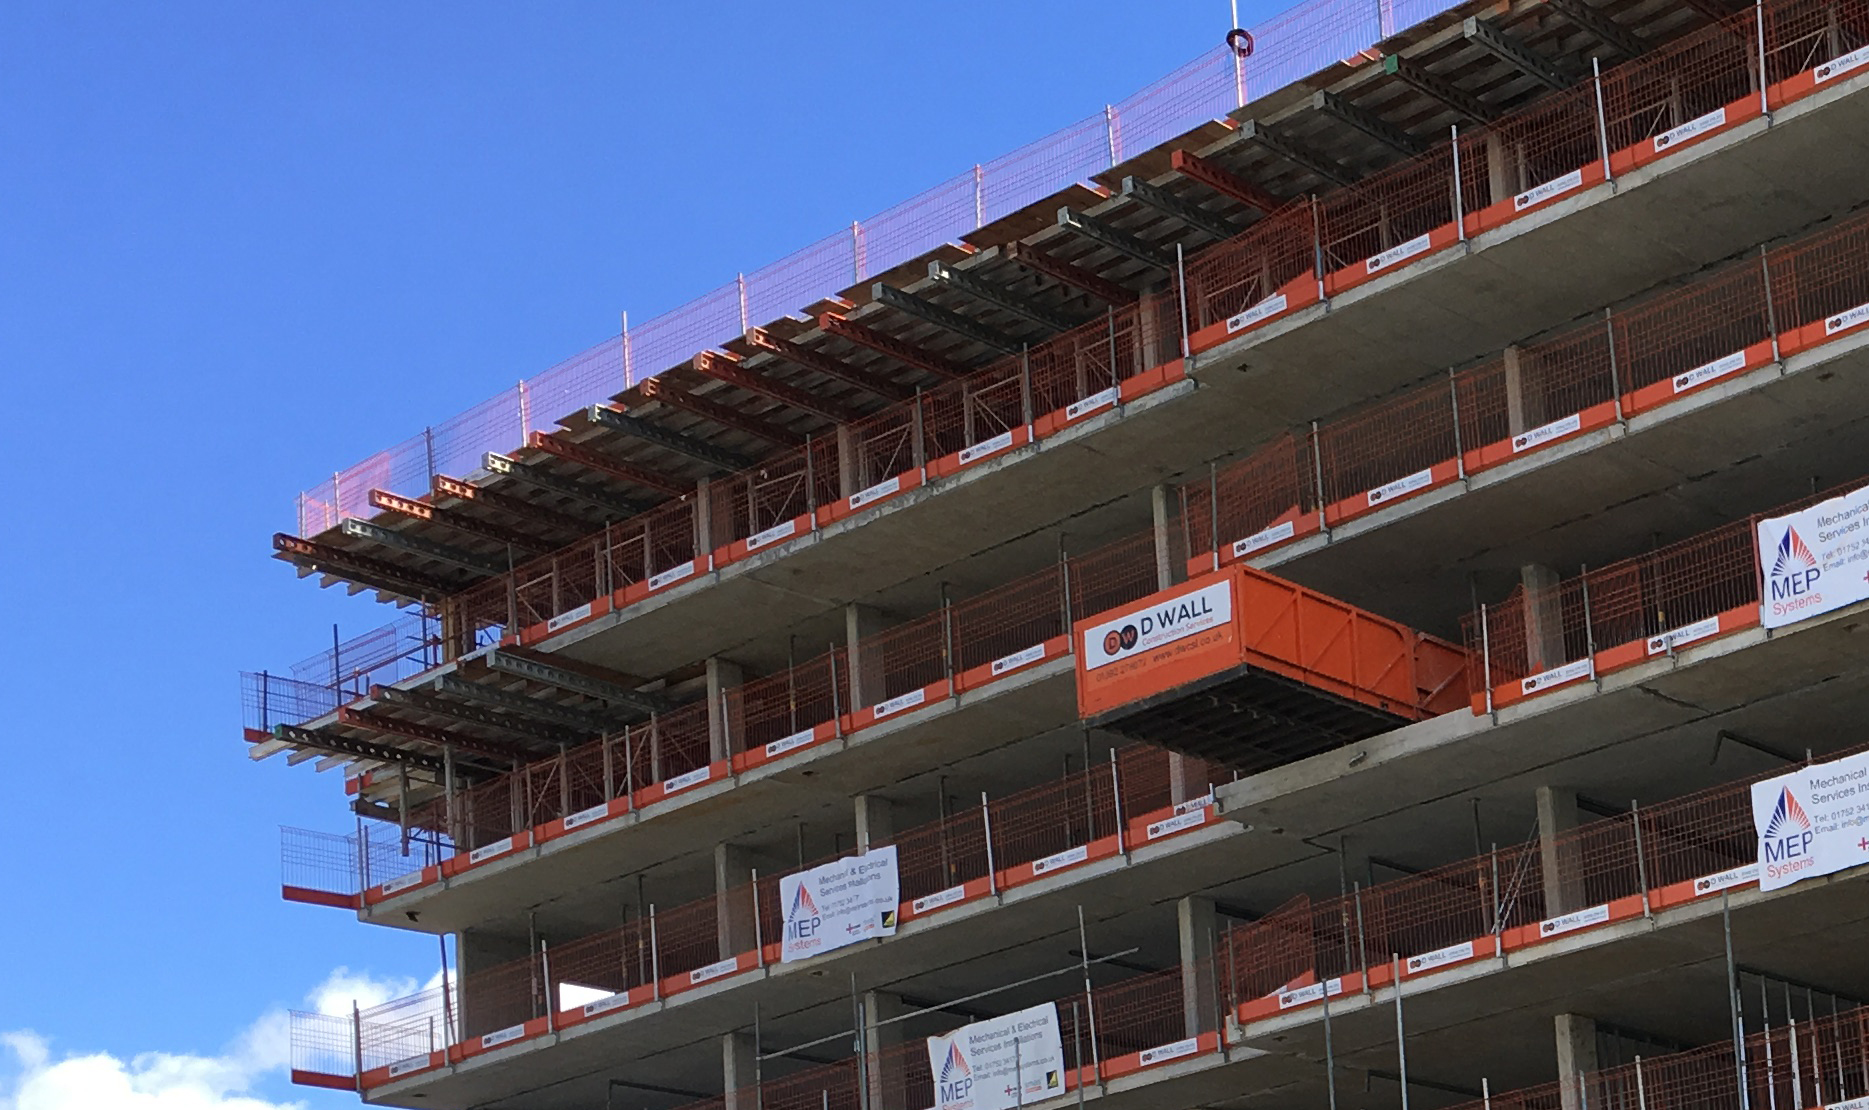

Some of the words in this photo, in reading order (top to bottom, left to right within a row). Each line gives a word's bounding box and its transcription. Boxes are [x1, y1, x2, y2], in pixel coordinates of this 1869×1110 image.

[1838, 53, 1858, 67] WALL
[1677, 123, 1695, 136] WALL
[1849, 306, 1869, 320] WALL
[1696, 364, 1715, 378] WALL
[1819, 520, 1860, 542] Services
[1772, 568, 1820, 601] MEP
[1773, 592, 1822, 616] Systems
[1141, 617, 1153, 636] D
[1157, 596, 1212, 628] WALL
[1142, 626, 1186, 646] Construction
[1543, 670, 1561, 681] WALL
[1810, 768, 1867, 790] Mechanical
[1812, 786, 1855, 805] Services
[1831, 807, 1854, 821] 01752
[1765, 831, 1813, 863] MEP
[1768, 857, 1814, 879] Systems
[1718, 872, 1737, 883] WALL
[1562, 914, 1580, 925] WALL
[788, 917, 821, 941] MEP
[788, 938, 821, 952] Sstems
[1018, 1016, 1048, 1031] Electrical
[971, 1042, 1001, 1056] Services
[941, 1078, 972, 1103] MEP
